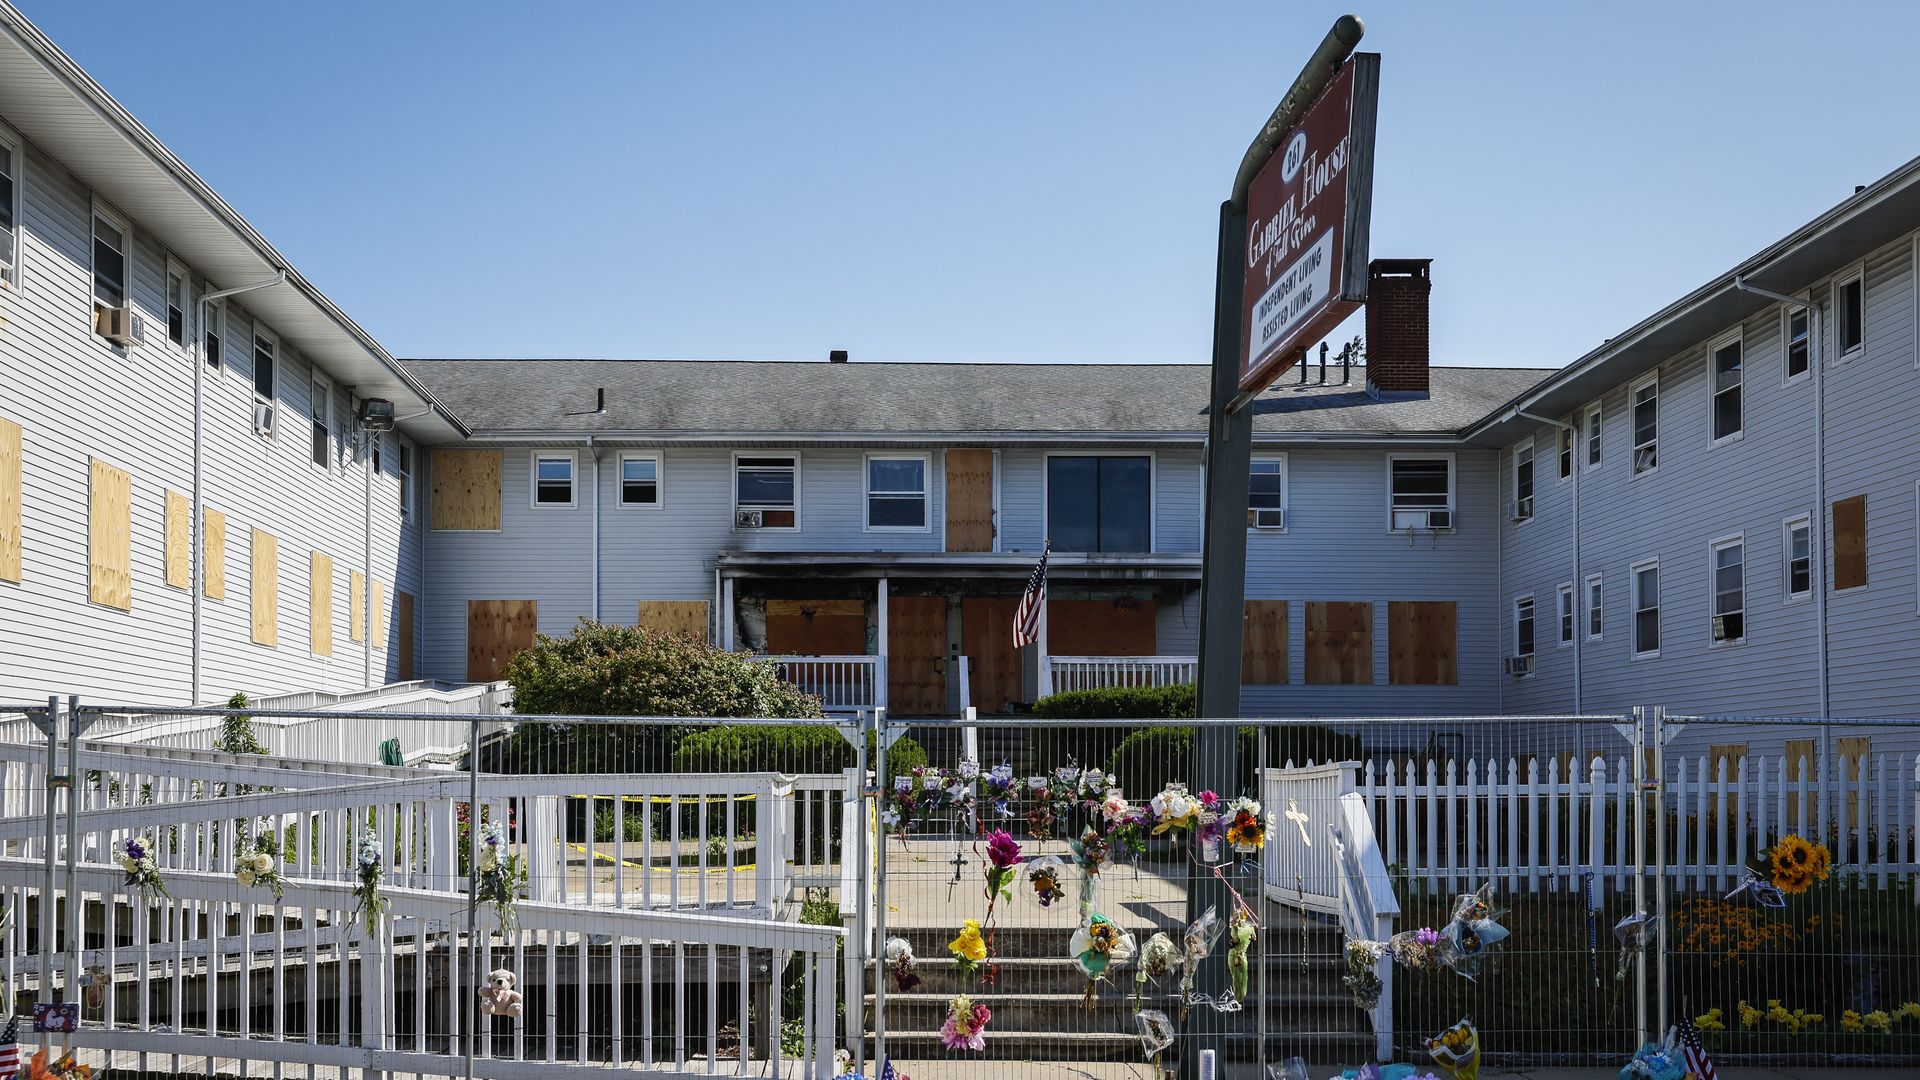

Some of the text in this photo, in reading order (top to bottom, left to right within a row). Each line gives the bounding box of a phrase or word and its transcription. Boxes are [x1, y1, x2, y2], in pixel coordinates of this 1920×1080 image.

[1287, 140, 1301, 175] 261
[1300, 135, 1348, 212] HOUSE
[1258, 246, 1322, 323] INDEPENDENT LIVING
[1265, 246, 1273, 286] of
[1290, 212, 1316, 250] River
[1262, 283, 1313, 344] ASSISTED LIVING
